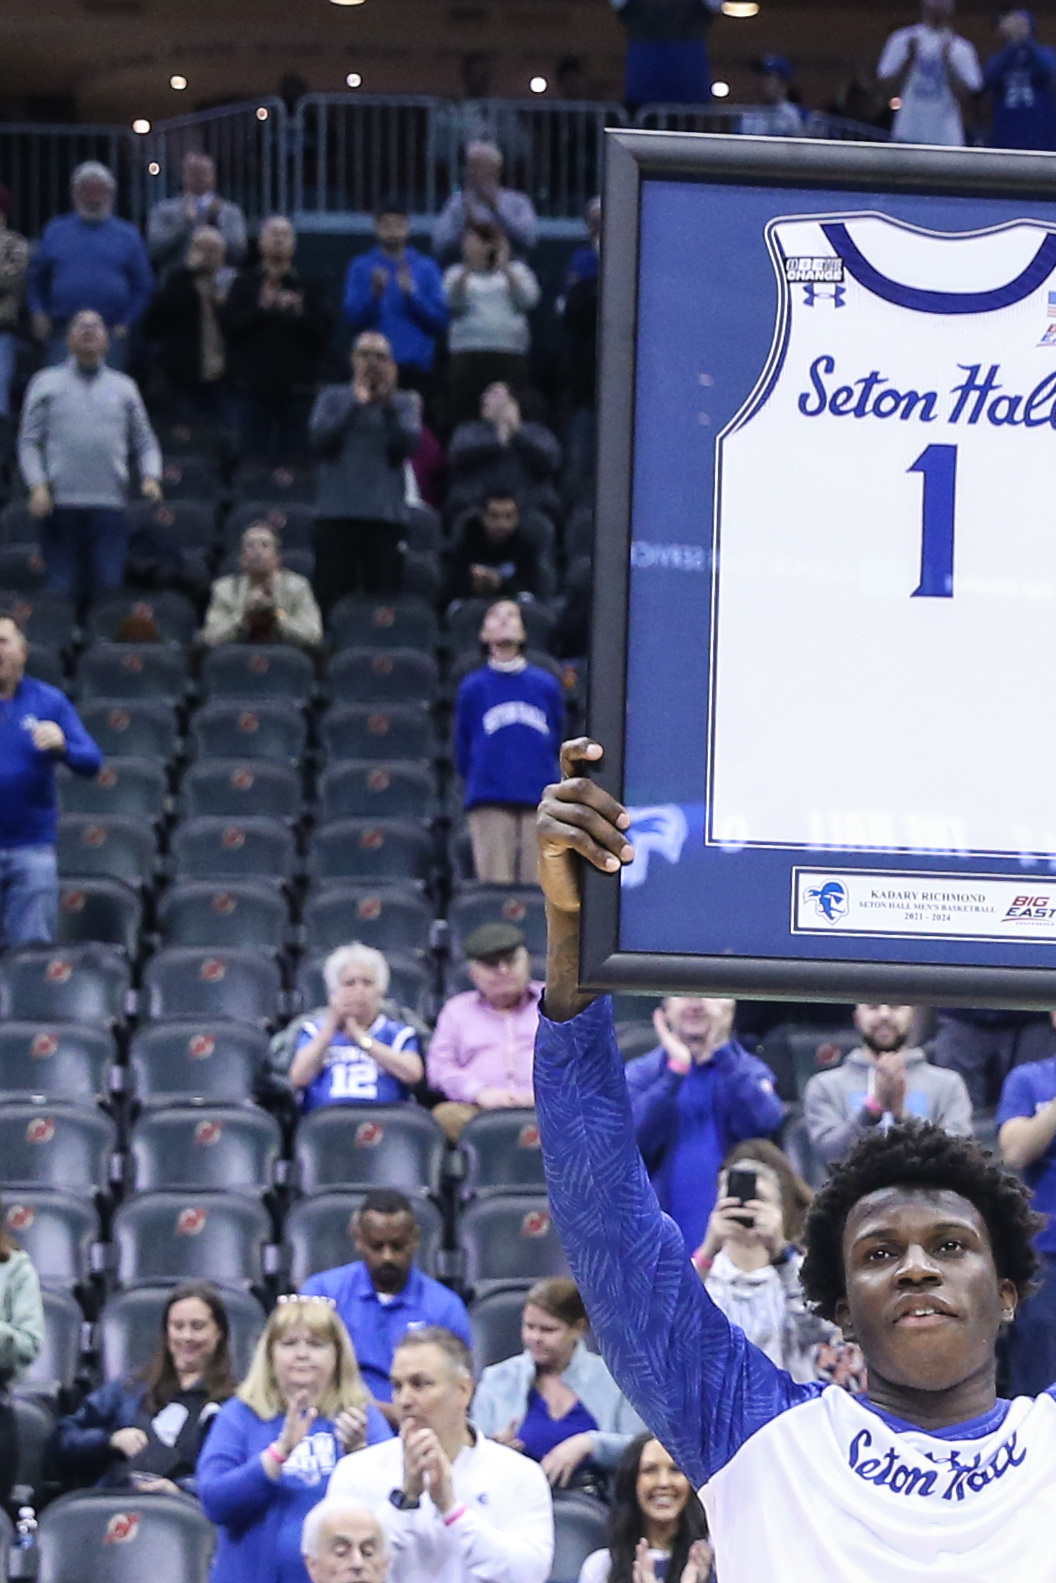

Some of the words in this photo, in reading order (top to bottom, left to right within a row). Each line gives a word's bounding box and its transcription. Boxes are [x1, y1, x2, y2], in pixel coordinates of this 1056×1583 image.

[787, 271, 842, 281] CHANGE
[798, 355, 938, 422] Seton
[906, 443, 957, 598] 1
[871, 889, 919, 900] KADARY
[921, 892, 986, 903] RICHMOND
[1012, 896, 1050, 907] BIG
[941, 904, 996, 913] BASKETBALL
[904, 912, 923, 920] 2021
[932, 913, 951, 921] 2024
[329, 1063, 378, 1099] 12
